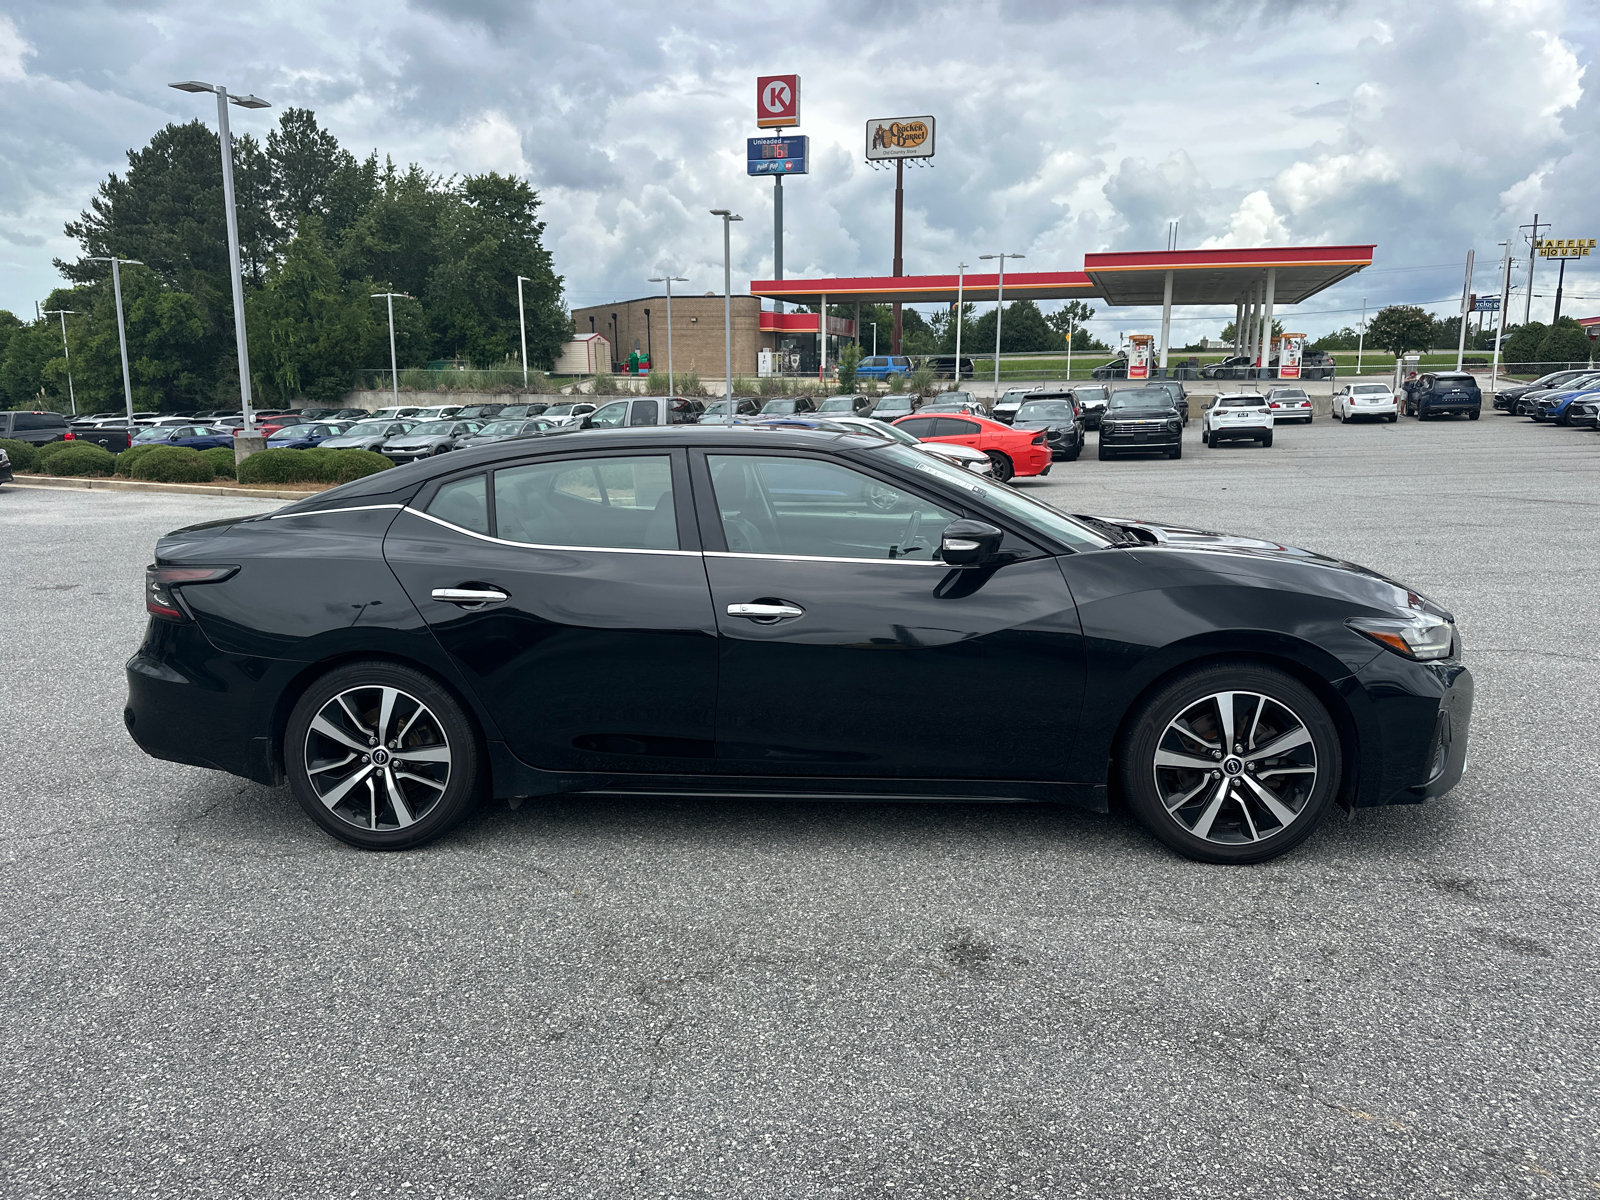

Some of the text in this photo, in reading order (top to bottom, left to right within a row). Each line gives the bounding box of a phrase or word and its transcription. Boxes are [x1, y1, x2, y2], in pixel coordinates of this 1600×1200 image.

[768, 84, 789, 111] K
[890, 123, 923, 137] Cracker
[896, 131, 925, 147] Barrel
[1536, 239, 1596, 248] WAFFLE
[1540, 248, 1589, 256] HOUSE
